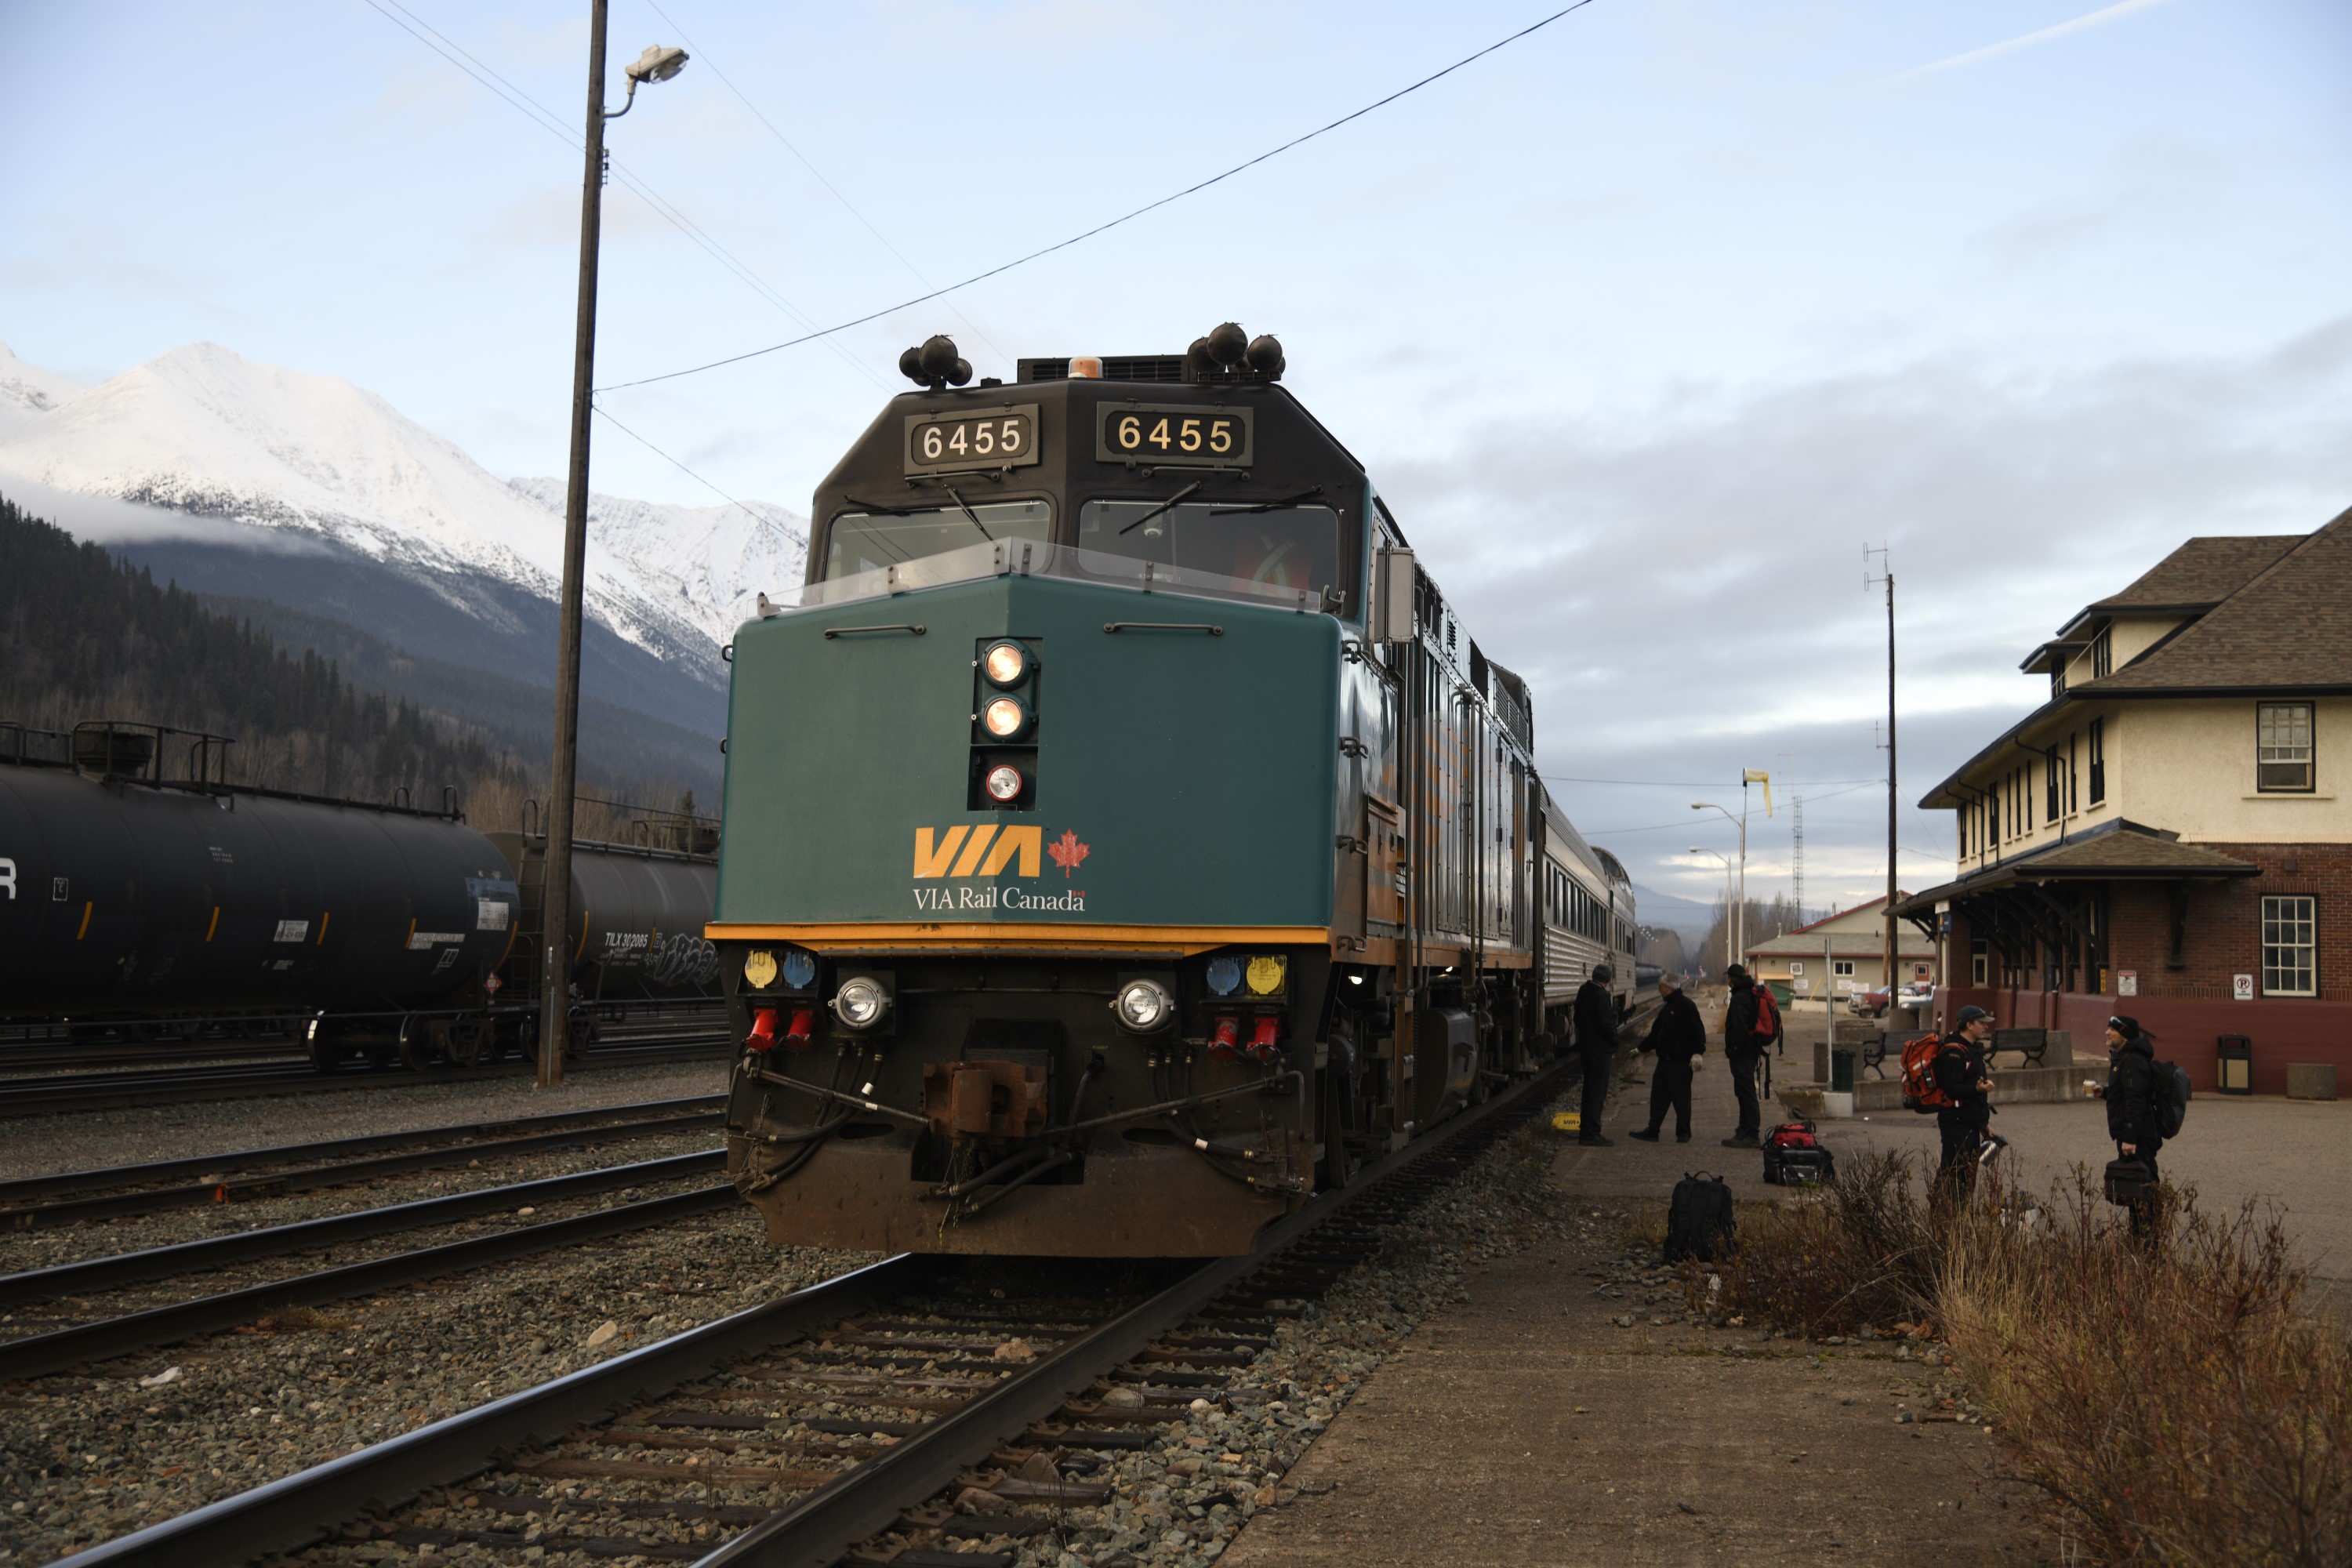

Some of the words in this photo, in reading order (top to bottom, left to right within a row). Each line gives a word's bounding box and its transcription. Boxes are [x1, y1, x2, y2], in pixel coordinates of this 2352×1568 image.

[924, 419, 1020, 459] 6455
[1119, 416, 1232, 452] 6455
[913, 824, 1042, 878] VIA
[913, 887, 955, 910] VIA
[959, 887, 998, 909] Rail
[1002, 887, 1086, 912] Canada
[604, 931, 622, 947] TILX
[622, 932, 649, 948] 302085
